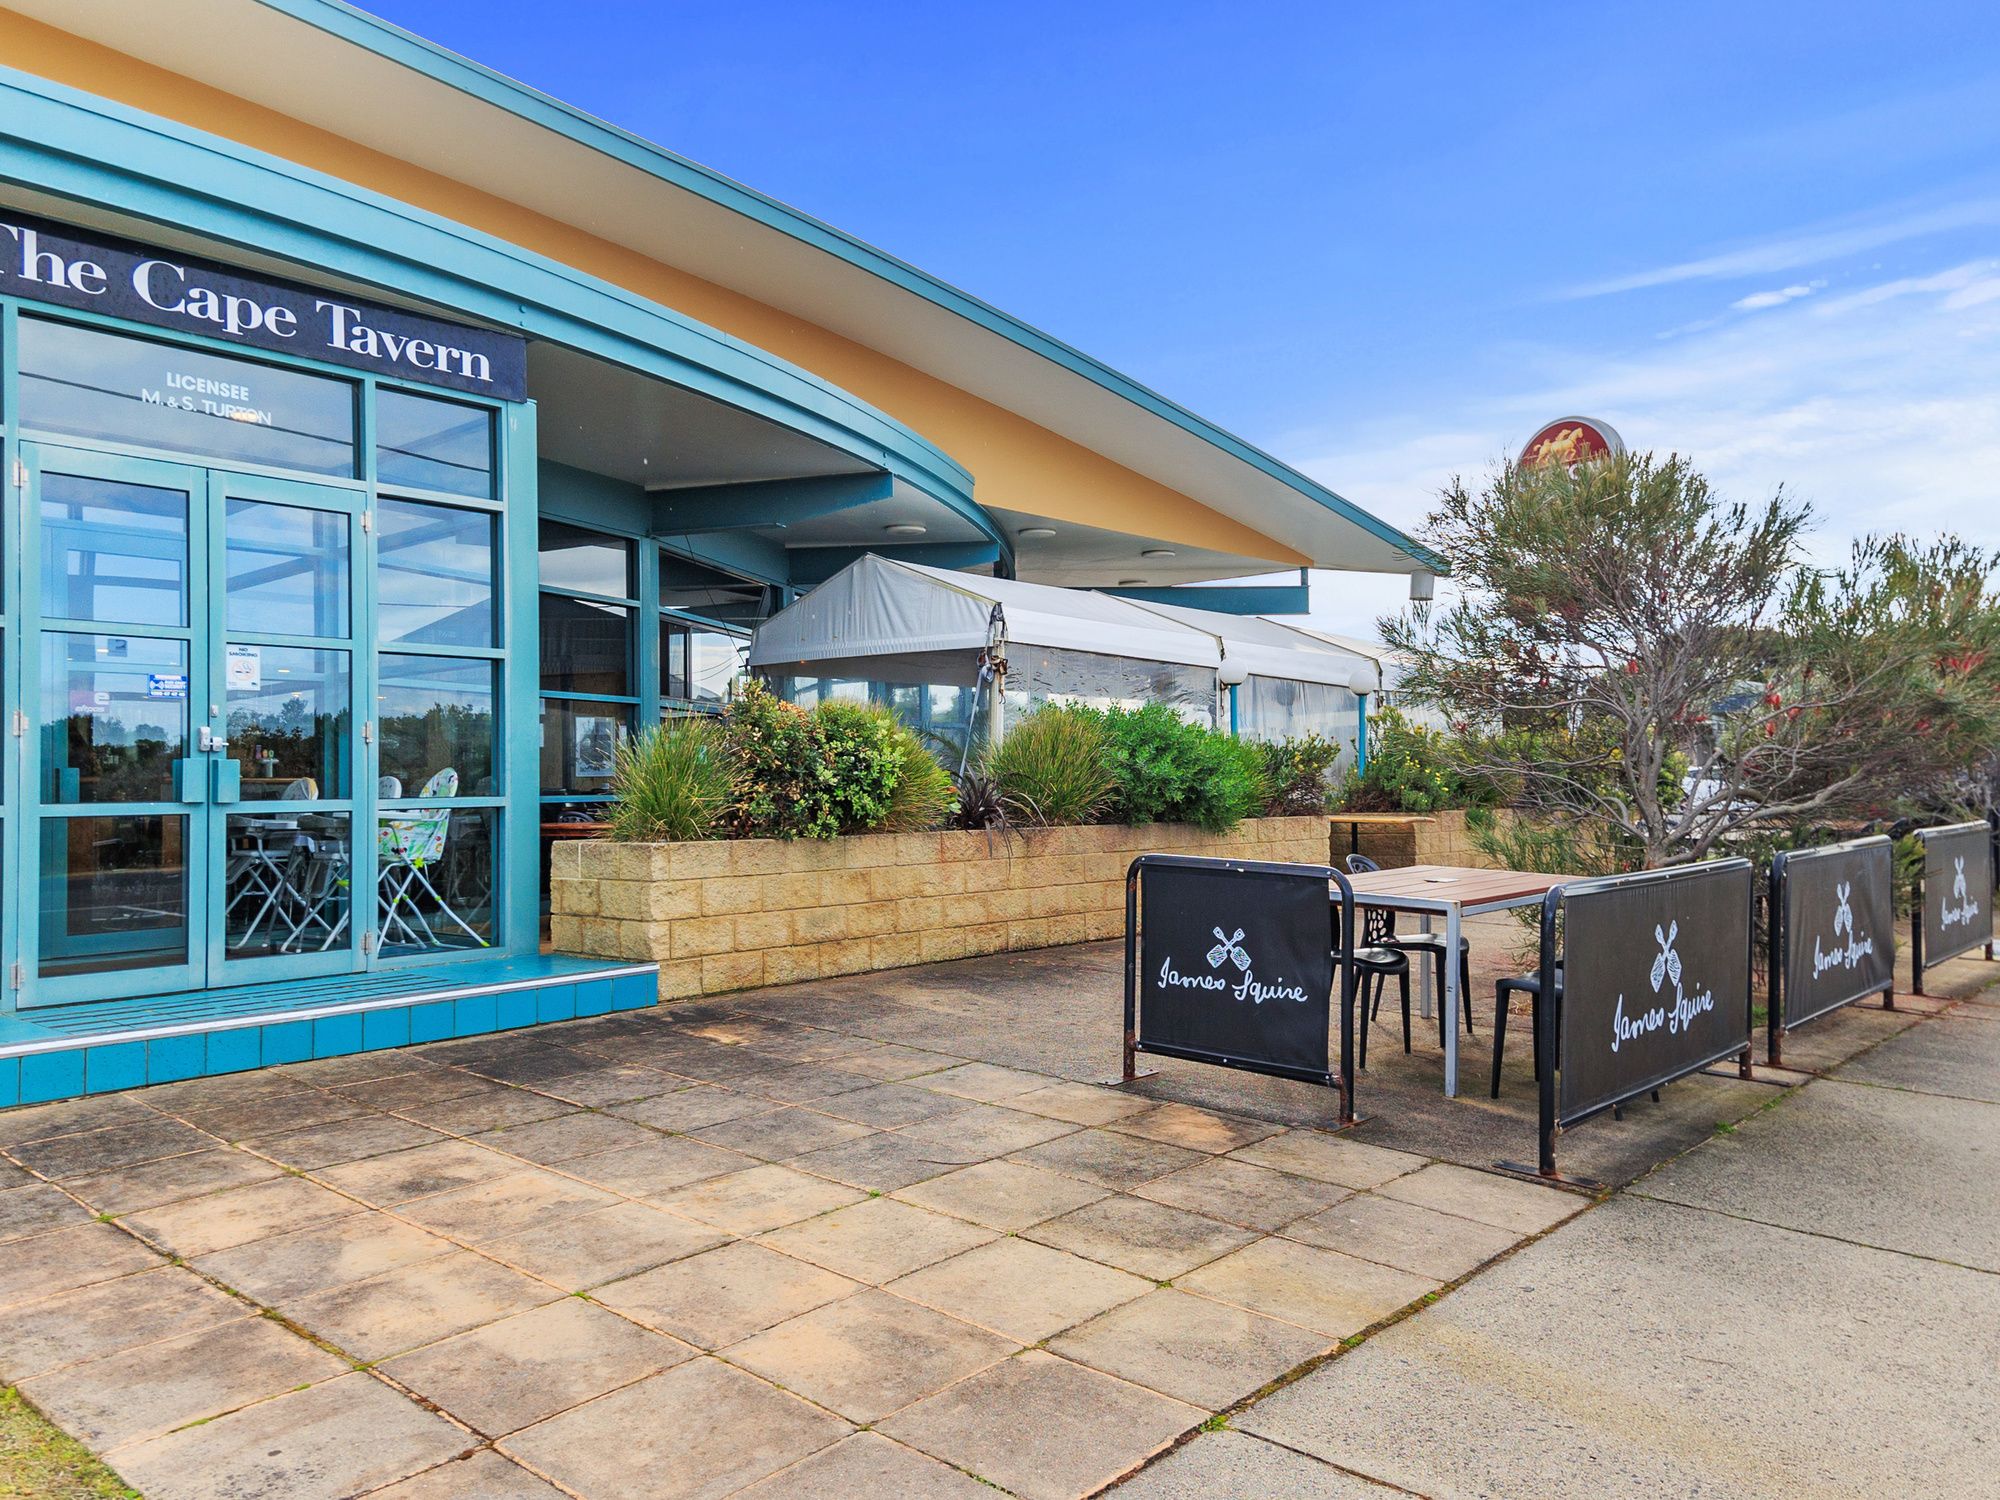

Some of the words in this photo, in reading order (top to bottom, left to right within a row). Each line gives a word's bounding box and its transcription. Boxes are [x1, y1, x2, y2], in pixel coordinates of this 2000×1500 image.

[132, 260, 298, 338] Cape
[315, 300, 494, 383] Tavern
[141, 388, 164, 406] M.
[166, 396, 179, 408] &
[181, 396, 198, 412] S.
[201, 399, 272, 426] TURTON
[166, 371, 249, 401] LICENSEE
[1813, 935, 1843, 980] James
[1844, 930, 1873, 970] Squire
[1157, 956, 1226, 989] James
[1232, 969, 1308, 1004] Squire
[1611, 993, 1665, 1053] James
[1667, 982, 1714, 1034] Squire
